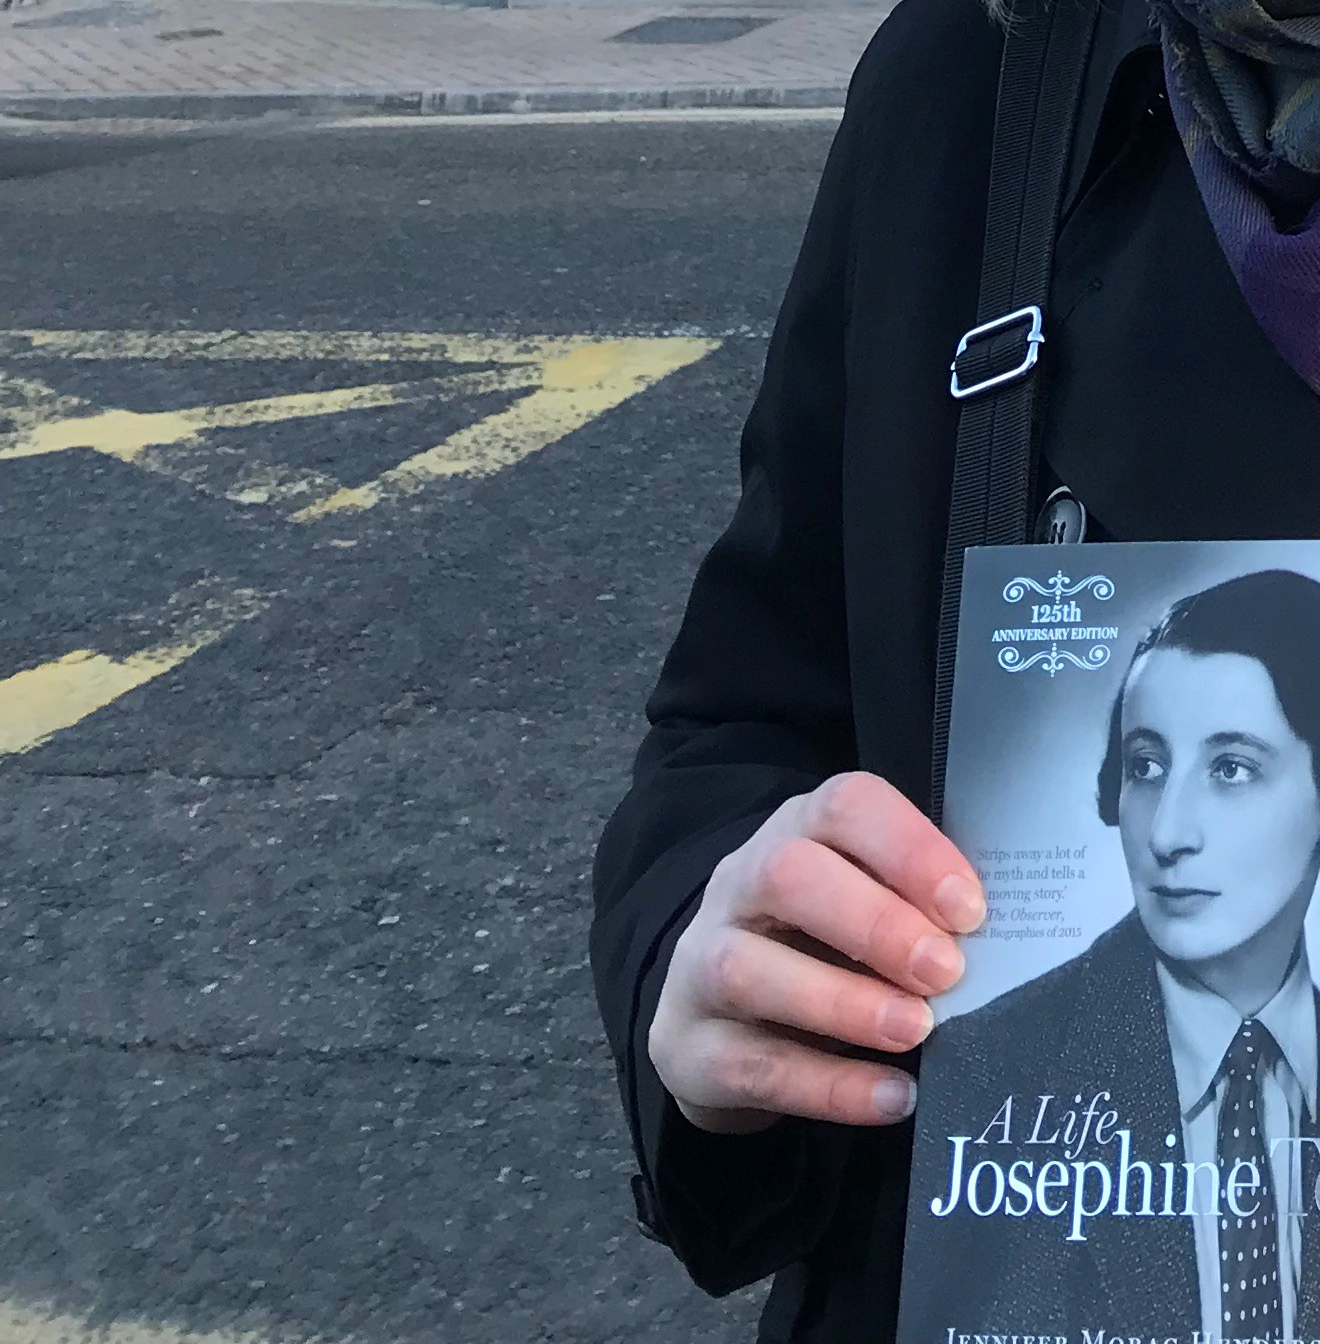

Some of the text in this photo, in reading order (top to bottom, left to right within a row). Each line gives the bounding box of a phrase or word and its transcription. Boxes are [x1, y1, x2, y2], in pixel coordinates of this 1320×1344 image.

[1031, 601, 1081, 623] 125th
[992, 627, 1118, 642] ANNIVERSARY EDITION
[1013, 850, 1042, 863] away
[1045, 851, 1052, 860] a
[1055, 845, 1070, 860] lot
[1073, 845, 1087, 860] of
[978, 865, 1085, 883] he myth and tells a
[988, 887, 1031, 903] moving
[987, 907, 1064, 922] The Observer,
[989, 926, 1044, 941] Biographies
[1046, 925, 1058, 938] of
[1059, 927, 1082, 938] 2015
[974, 1091, 1118, 1160] A Life
[930, 1129, 1261, 1241] Josephine
